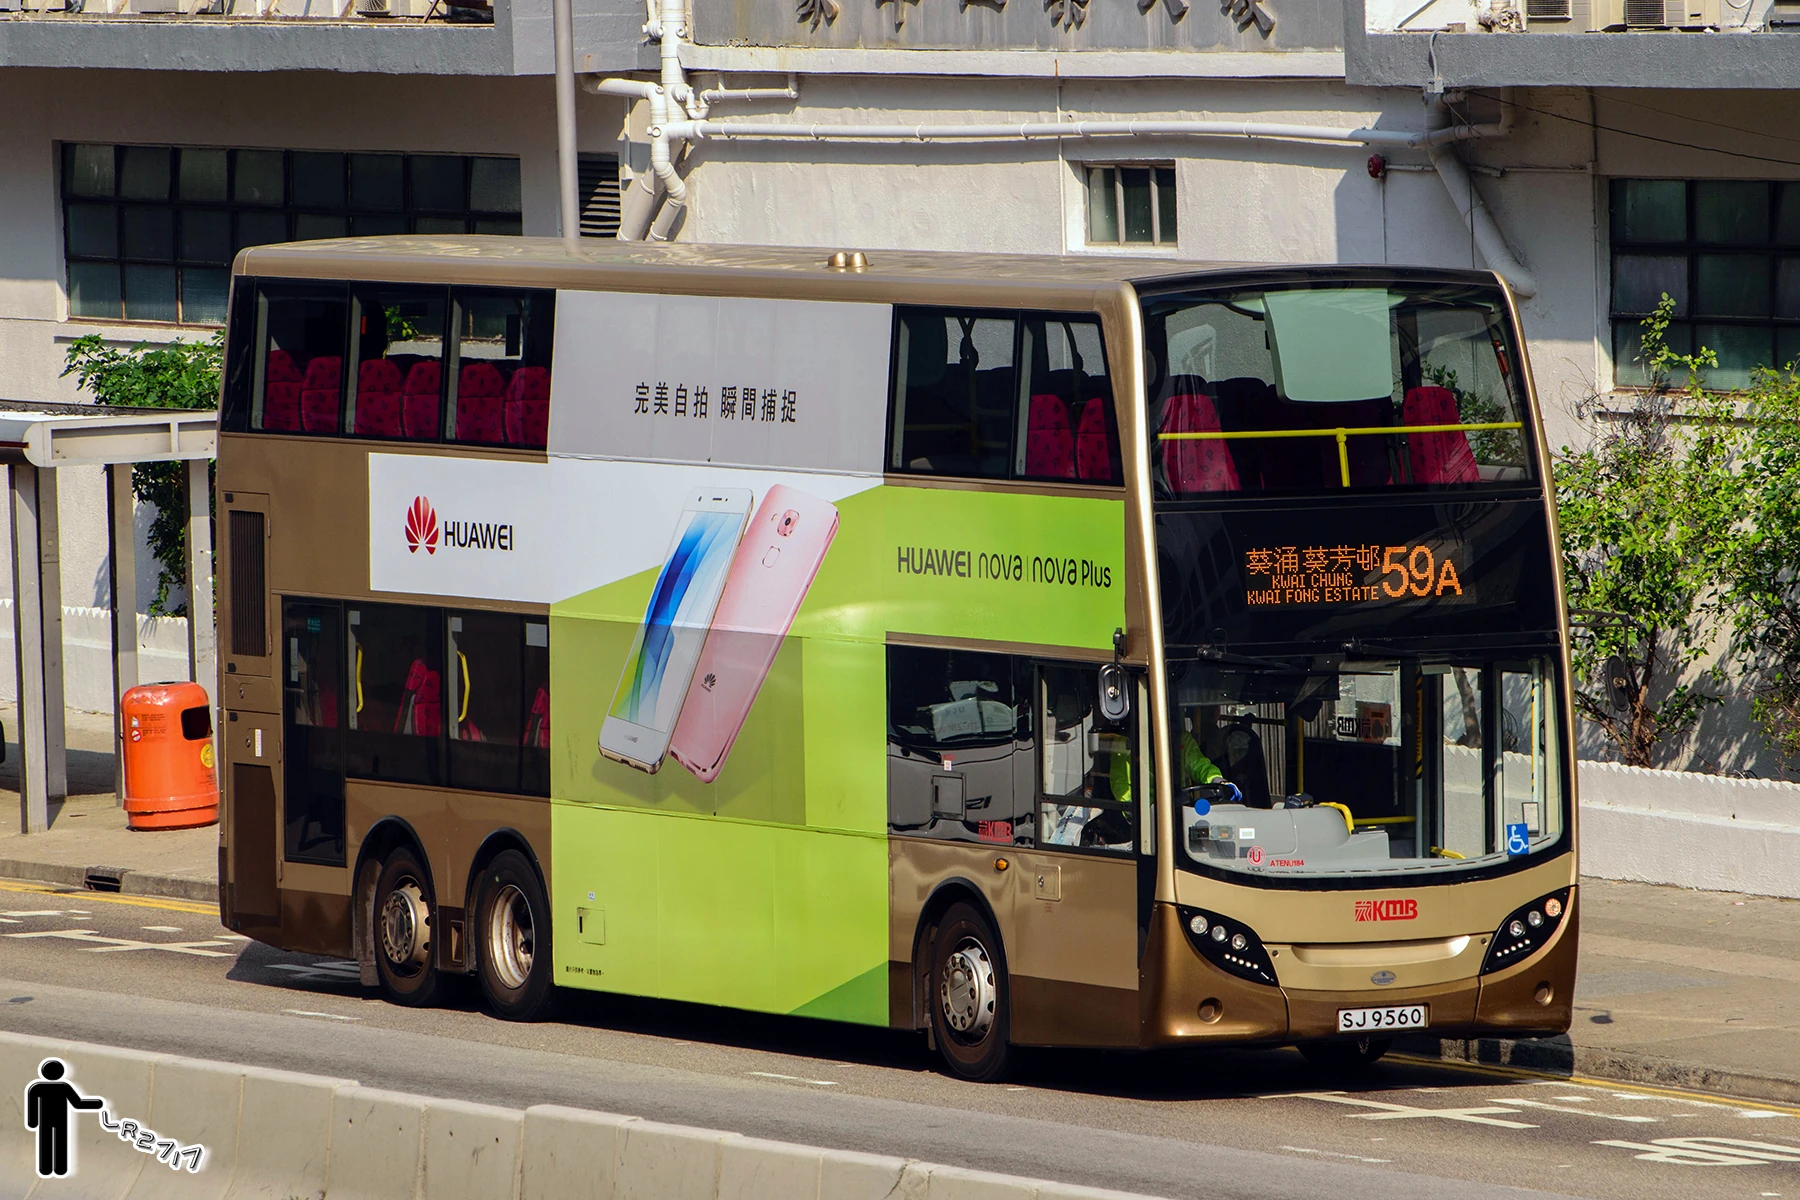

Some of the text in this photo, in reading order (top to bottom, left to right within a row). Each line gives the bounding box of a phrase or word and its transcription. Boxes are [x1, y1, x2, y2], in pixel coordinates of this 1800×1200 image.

[634, 382, 797, 423] 完美自拍 瞬間捕捉
[444, 520, 513, 551] HUAWEI
[897, 546, 1112, 588] HUAWEI nova nova Plus
[1246, 544, 1381, 575] 葵涌 葵芳邨
[1382, 545, 1463, 598] 59A
[1247, 585, 1379, 604] KWAI FONG ESTATE
[1272, 572, 1353, 589] KWAI CHUNG
[1372, 899, 1419, 921] KMB
[1342, 1008, 1422, 1028] SJ 9560
